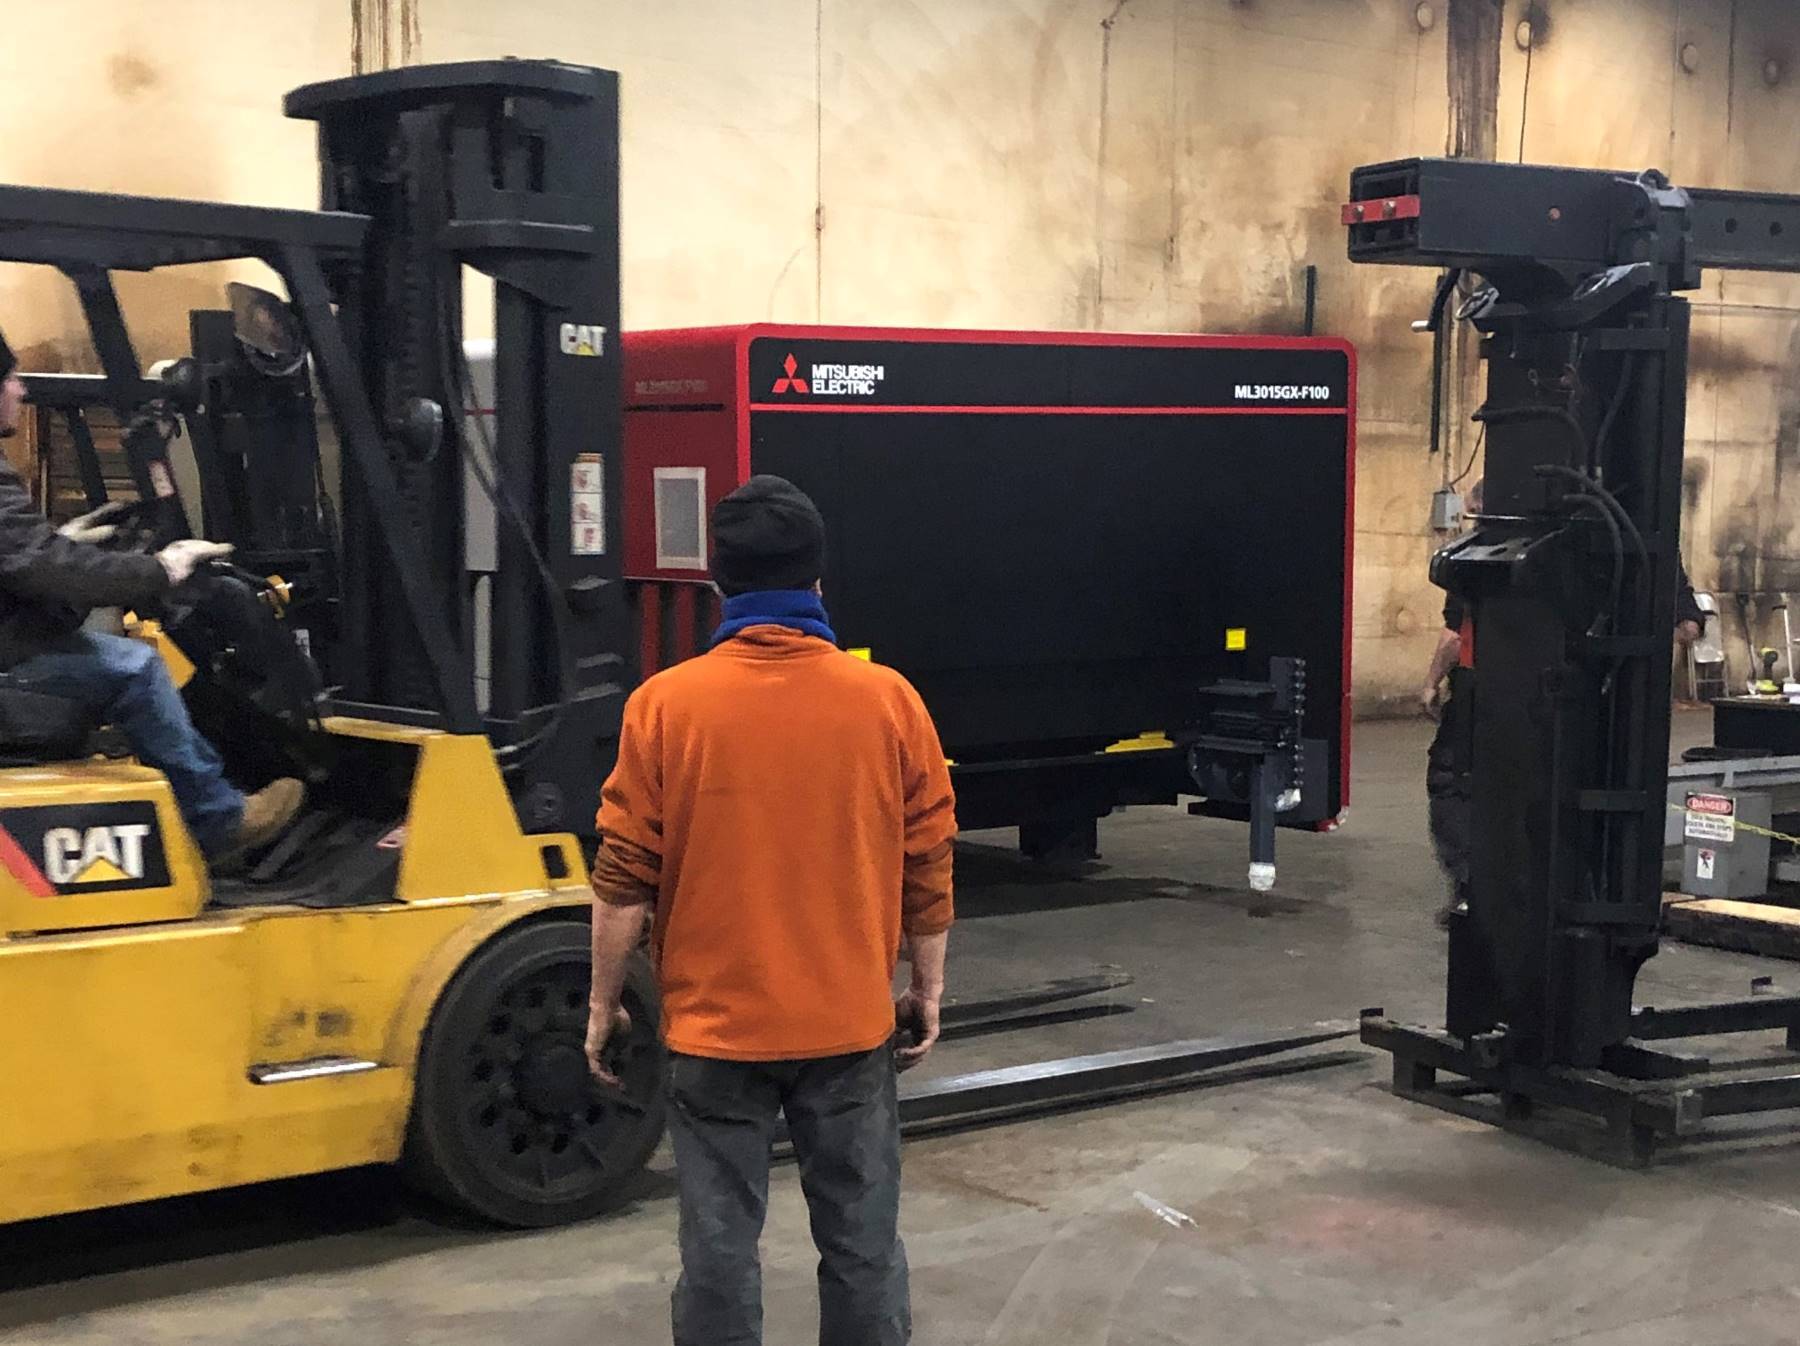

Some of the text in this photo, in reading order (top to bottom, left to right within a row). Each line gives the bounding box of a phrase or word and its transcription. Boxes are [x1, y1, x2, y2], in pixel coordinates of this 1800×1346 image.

[560, 322, 607, 357] CAT
[812, 364, 884, 380] MITSUBISHI
[812, 380, 875, 395] ELECTRIC
[1234, 385, 1330, 400] ML3015GX-F100
[1692, 799, 1727, 812] DANGER
[42, 824, 151, 884] CAT
